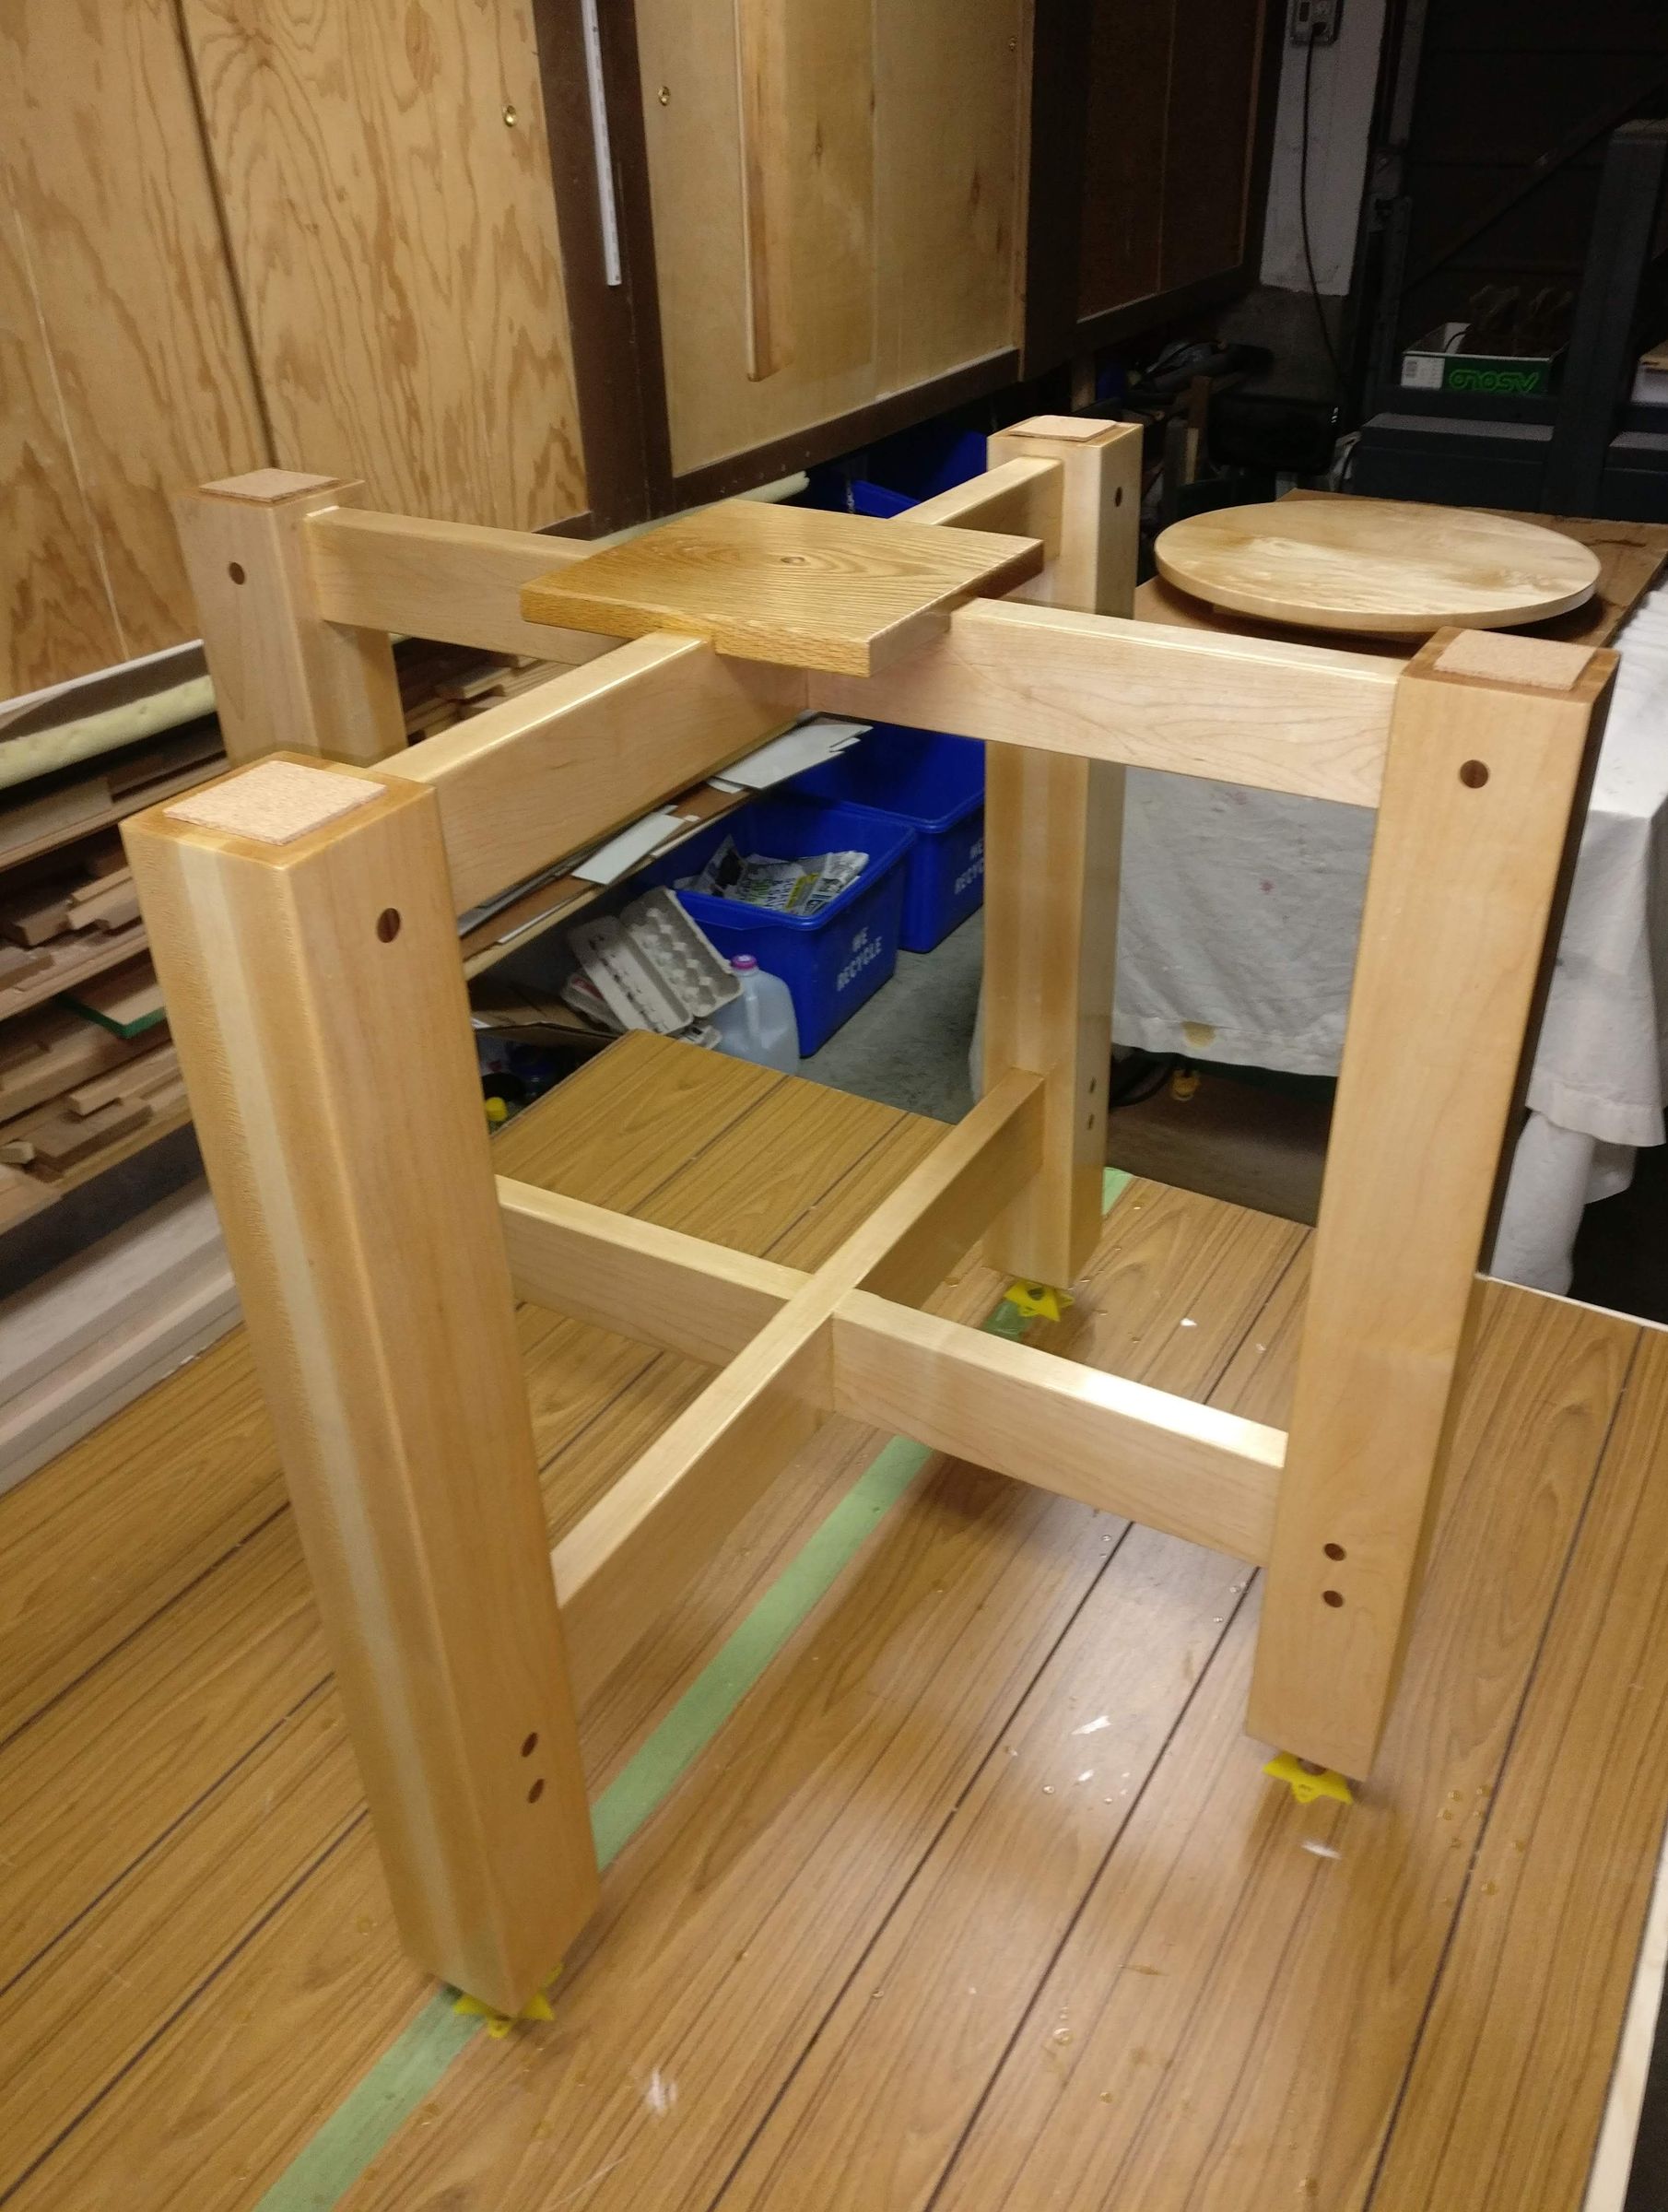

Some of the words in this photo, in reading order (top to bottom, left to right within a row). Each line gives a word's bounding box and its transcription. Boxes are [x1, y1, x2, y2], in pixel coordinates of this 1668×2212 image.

[1449, 369, 1539, 392] ASOLO
[852, 926, 868, 953] WE
[837, 936, 883, 992] RECYCLE
